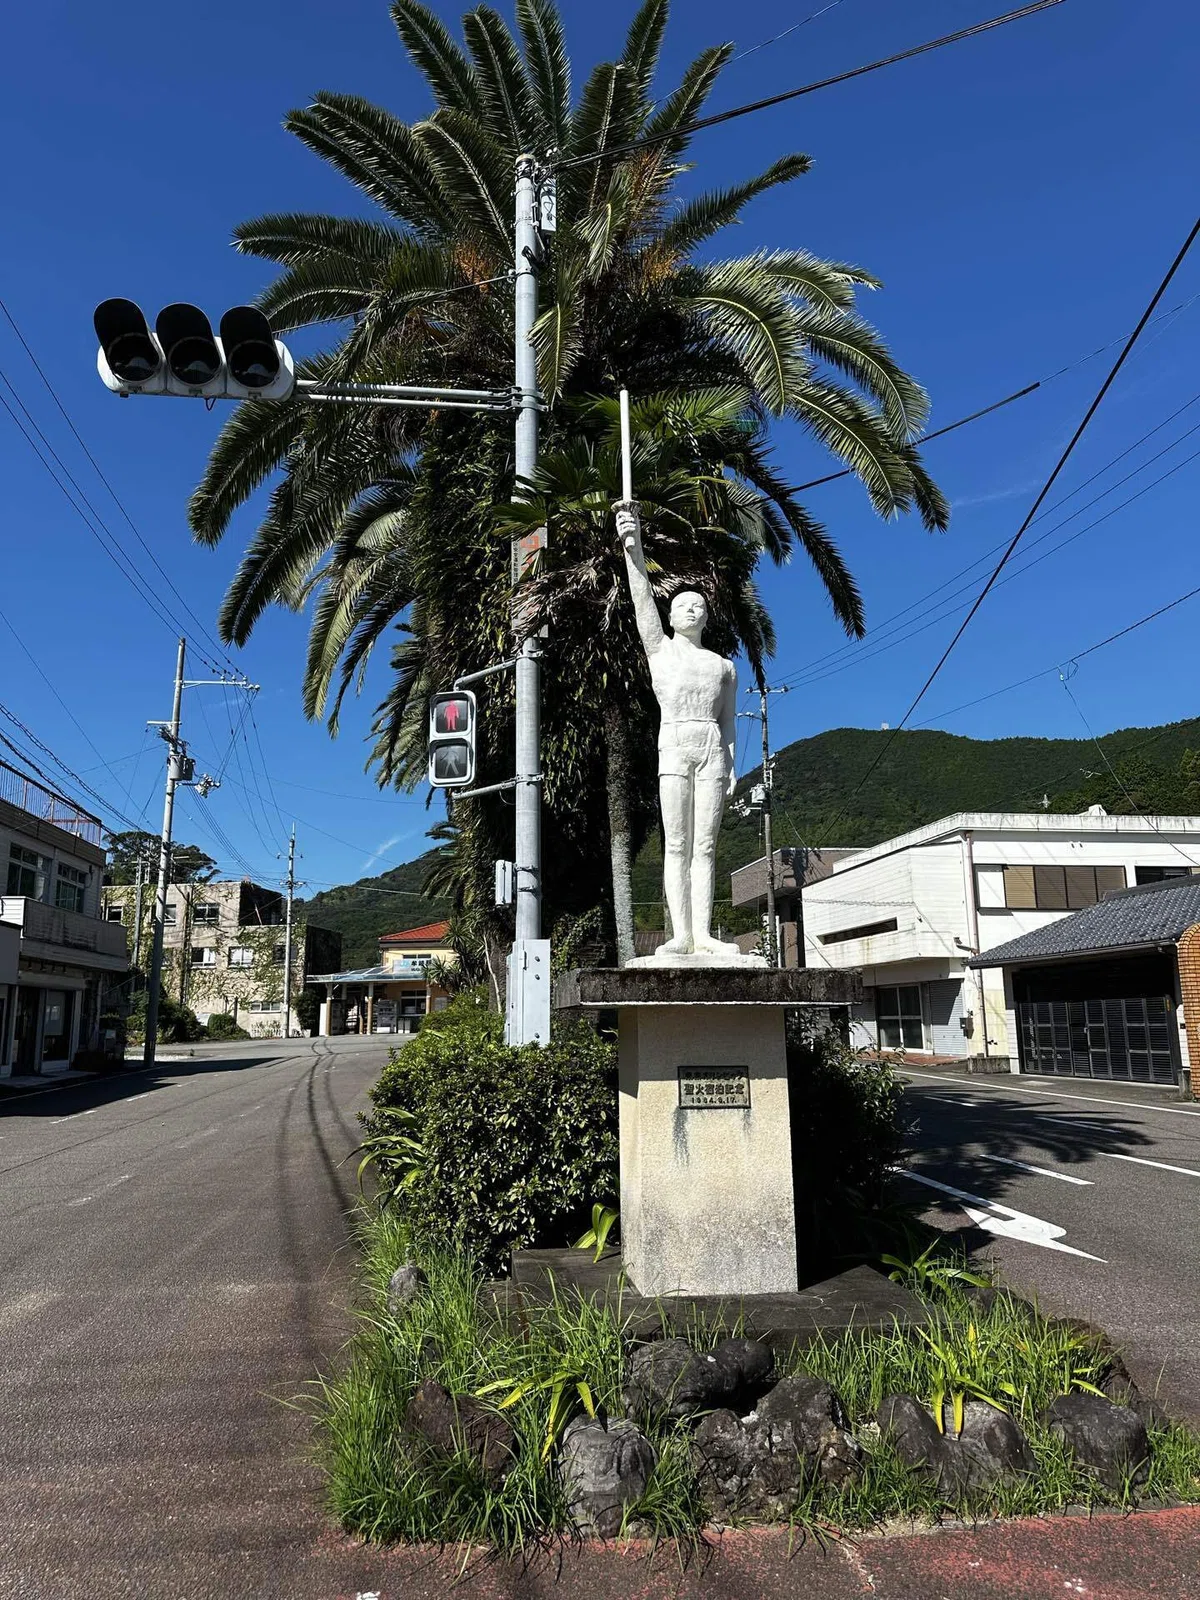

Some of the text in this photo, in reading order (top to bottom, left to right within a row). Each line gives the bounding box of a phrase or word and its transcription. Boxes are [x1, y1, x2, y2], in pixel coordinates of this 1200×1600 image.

[684, 1083, 745, 1095] 聖火宿泊記念
